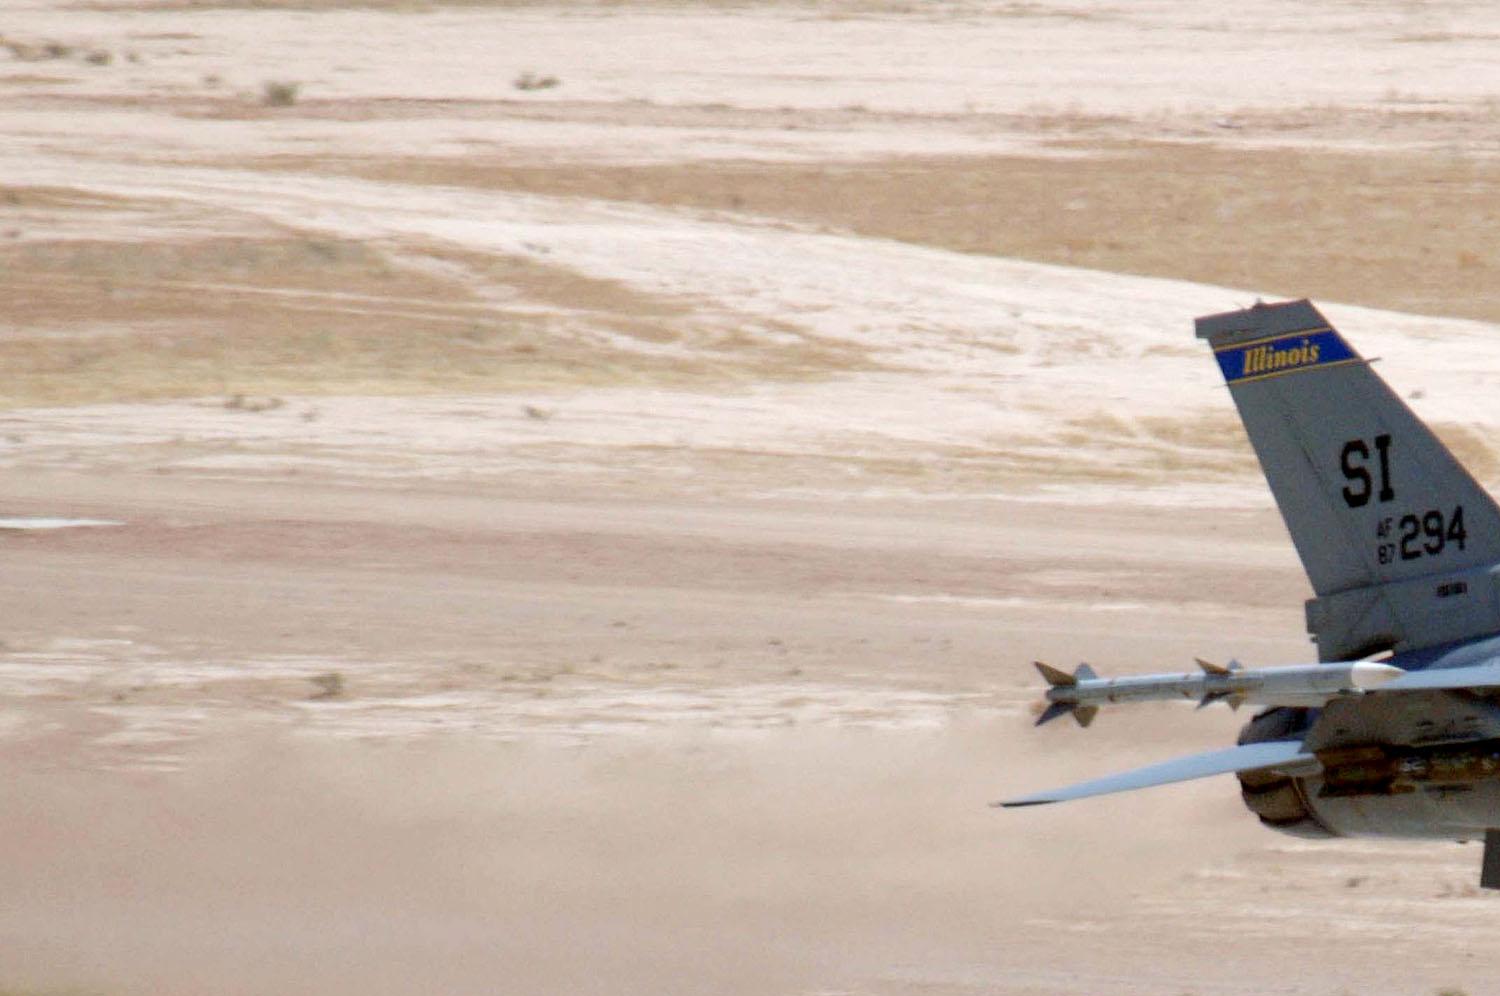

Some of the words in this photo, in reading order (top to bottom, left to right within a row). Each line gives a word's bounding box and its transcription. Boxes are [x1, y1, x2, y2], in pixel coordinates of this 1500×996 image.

[1243, 338, 1320, 374] Illinois
[1340, 433, 1395, 508] SI
[1377, 543, 1396, 565] 87
[1400, 505, 1467, 560] 294
